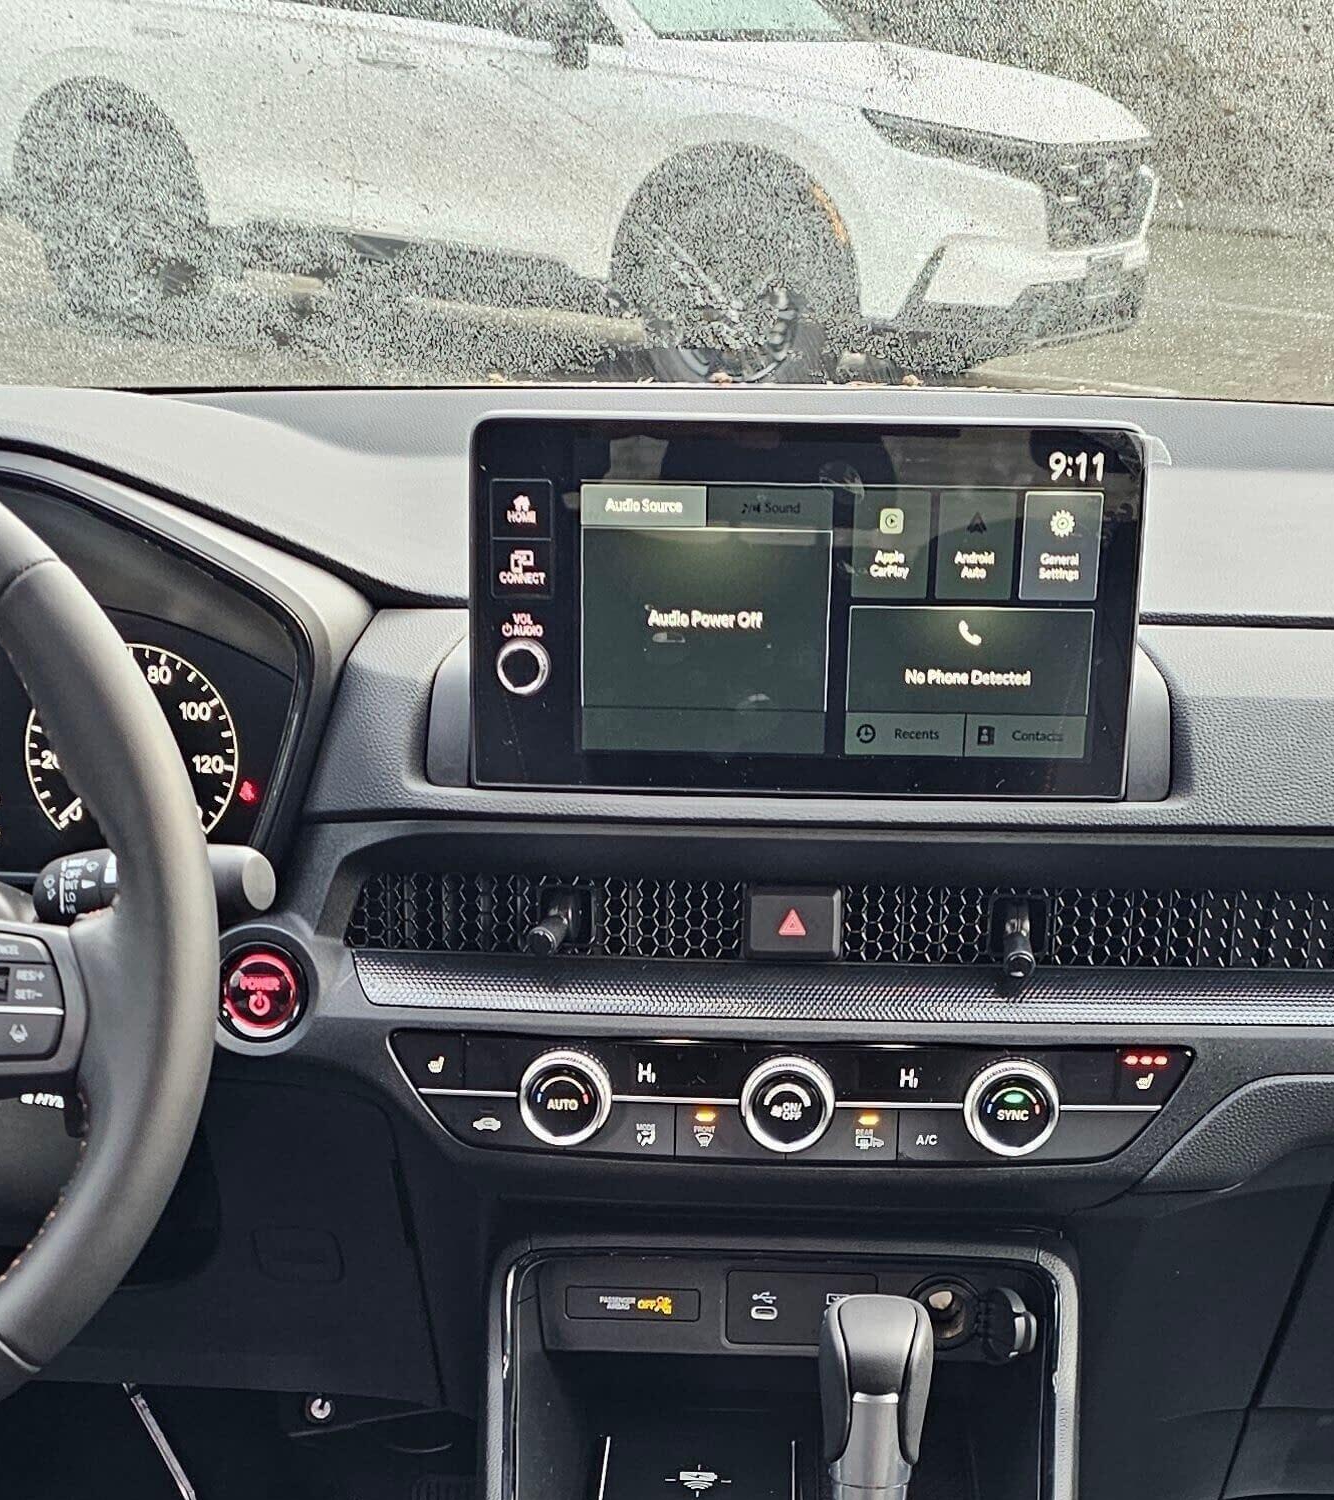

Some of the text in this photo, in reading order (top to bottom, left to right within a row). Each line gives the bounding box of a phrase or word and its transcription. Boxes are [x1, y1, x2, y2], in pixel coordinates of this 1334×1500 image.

[1048, 451, 1105, 482] 9:11
[605, 497, 684, 513] Audio Source
[764, 501, 801, 514] Sound
[506, 510, 537, 525] HOME
[875, 550, 905, 565] Apple
[954, 551, 995, 566] Android
[1040, 553, 1080, 567] General
[499, 571, 546, 586] CONNECT
[869, 564, 910, 581] CarPlay
[961, 566, 987, 580] Auto
[1038, 567, 1080, 581] Settings
[512, 613, 533, 625] VOL
[647, 609, 764, 629] Audio Power Off
[513, 624, 544, 638] AUDIO
[147, 665, 172, 685] 80
[904, 668, 1032, 686] No Phone Detected
[178, 701, 212, 721] 100
[894, 728, 939, 740] Recents
[192, 754, 225, 774] 120
[64, 891, 76, 903] LO
[547, 1099, 579, 1111] AUTO
[782, 1111, 802, 1121] OFF
[997, 1109, 1029, 1122] SYNC
[694, 1126, 716, 1134] FRONT
[915, 1133, 938, 1146] A/C
[637, 1299, 656, 1310] OFF
